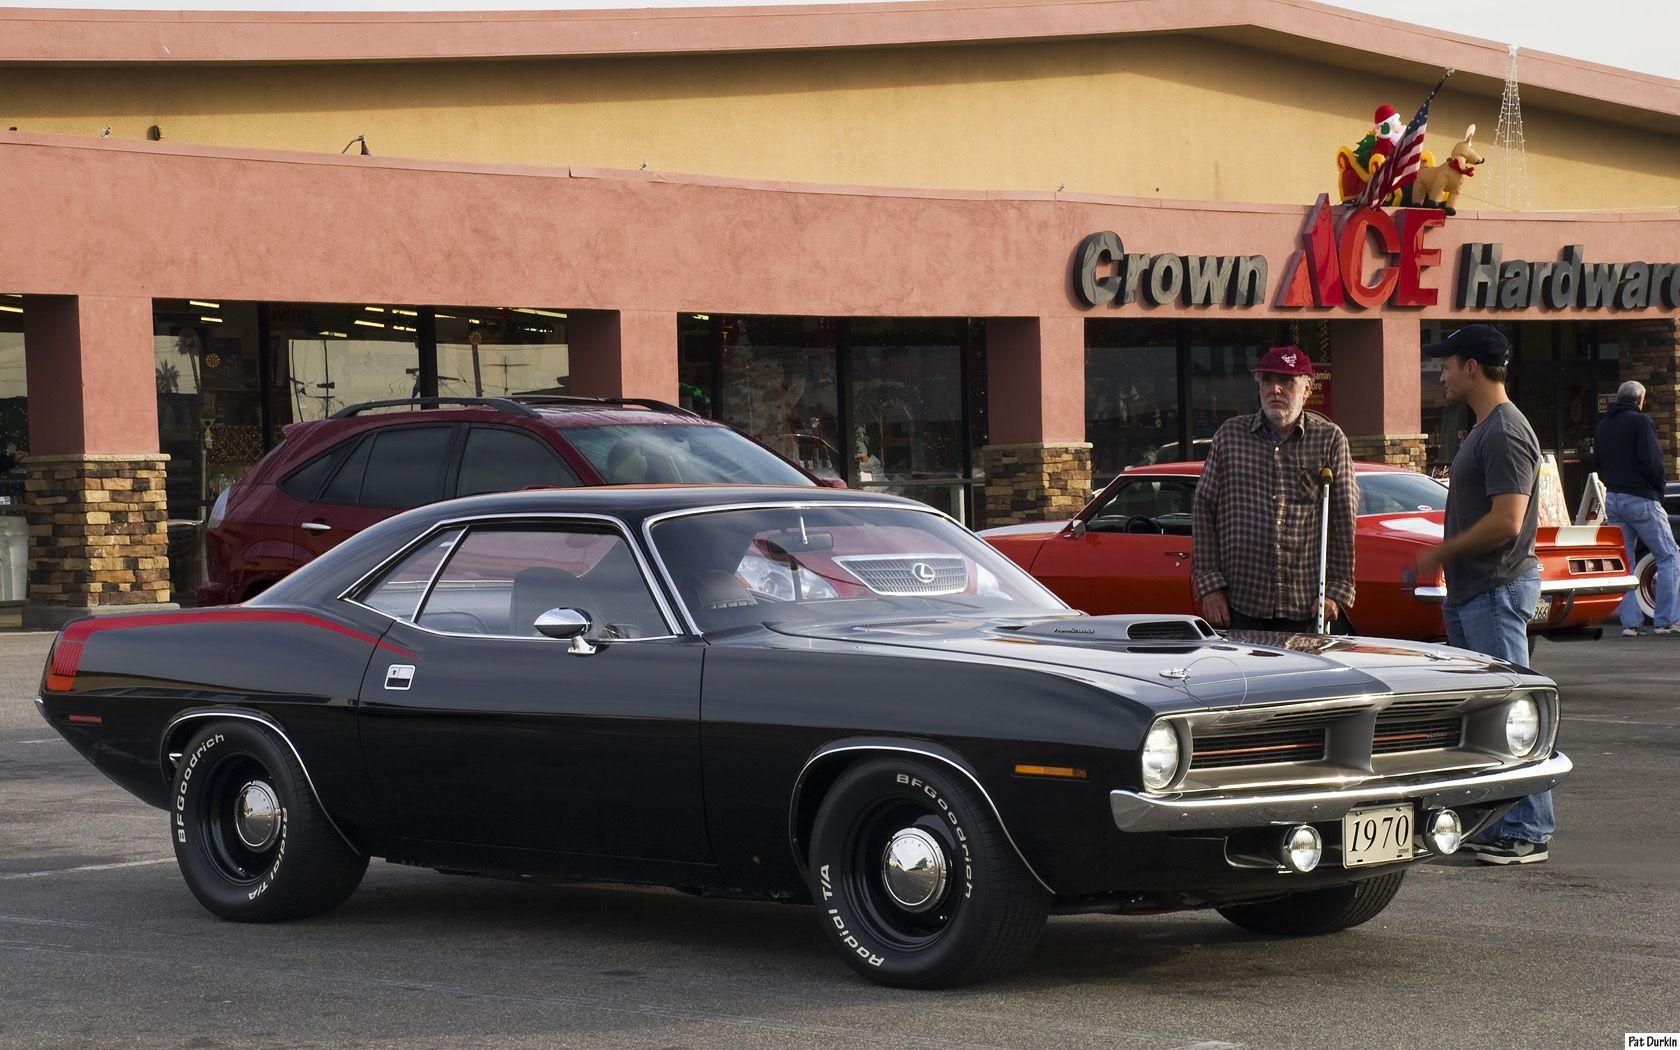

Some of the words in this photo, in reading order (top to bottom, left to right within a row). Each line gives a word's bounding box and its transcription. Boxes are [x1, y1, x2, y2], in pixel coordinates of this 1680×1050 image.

[1075, 231, 1268, 305] Crown
[1276, 193, 1446, 308] ACE
[1312, 370, 1331, 381] jamin
[176, 733, 225, 843] BFGoodrich
[896, 773, 973, 899] BFGoodrich
[1349, 814, 1409, 852] 1970
[248, 881, 268, 901] T/A
[820, 864, 833, 901] T/A
[828, 908, 885, 967] Radial
